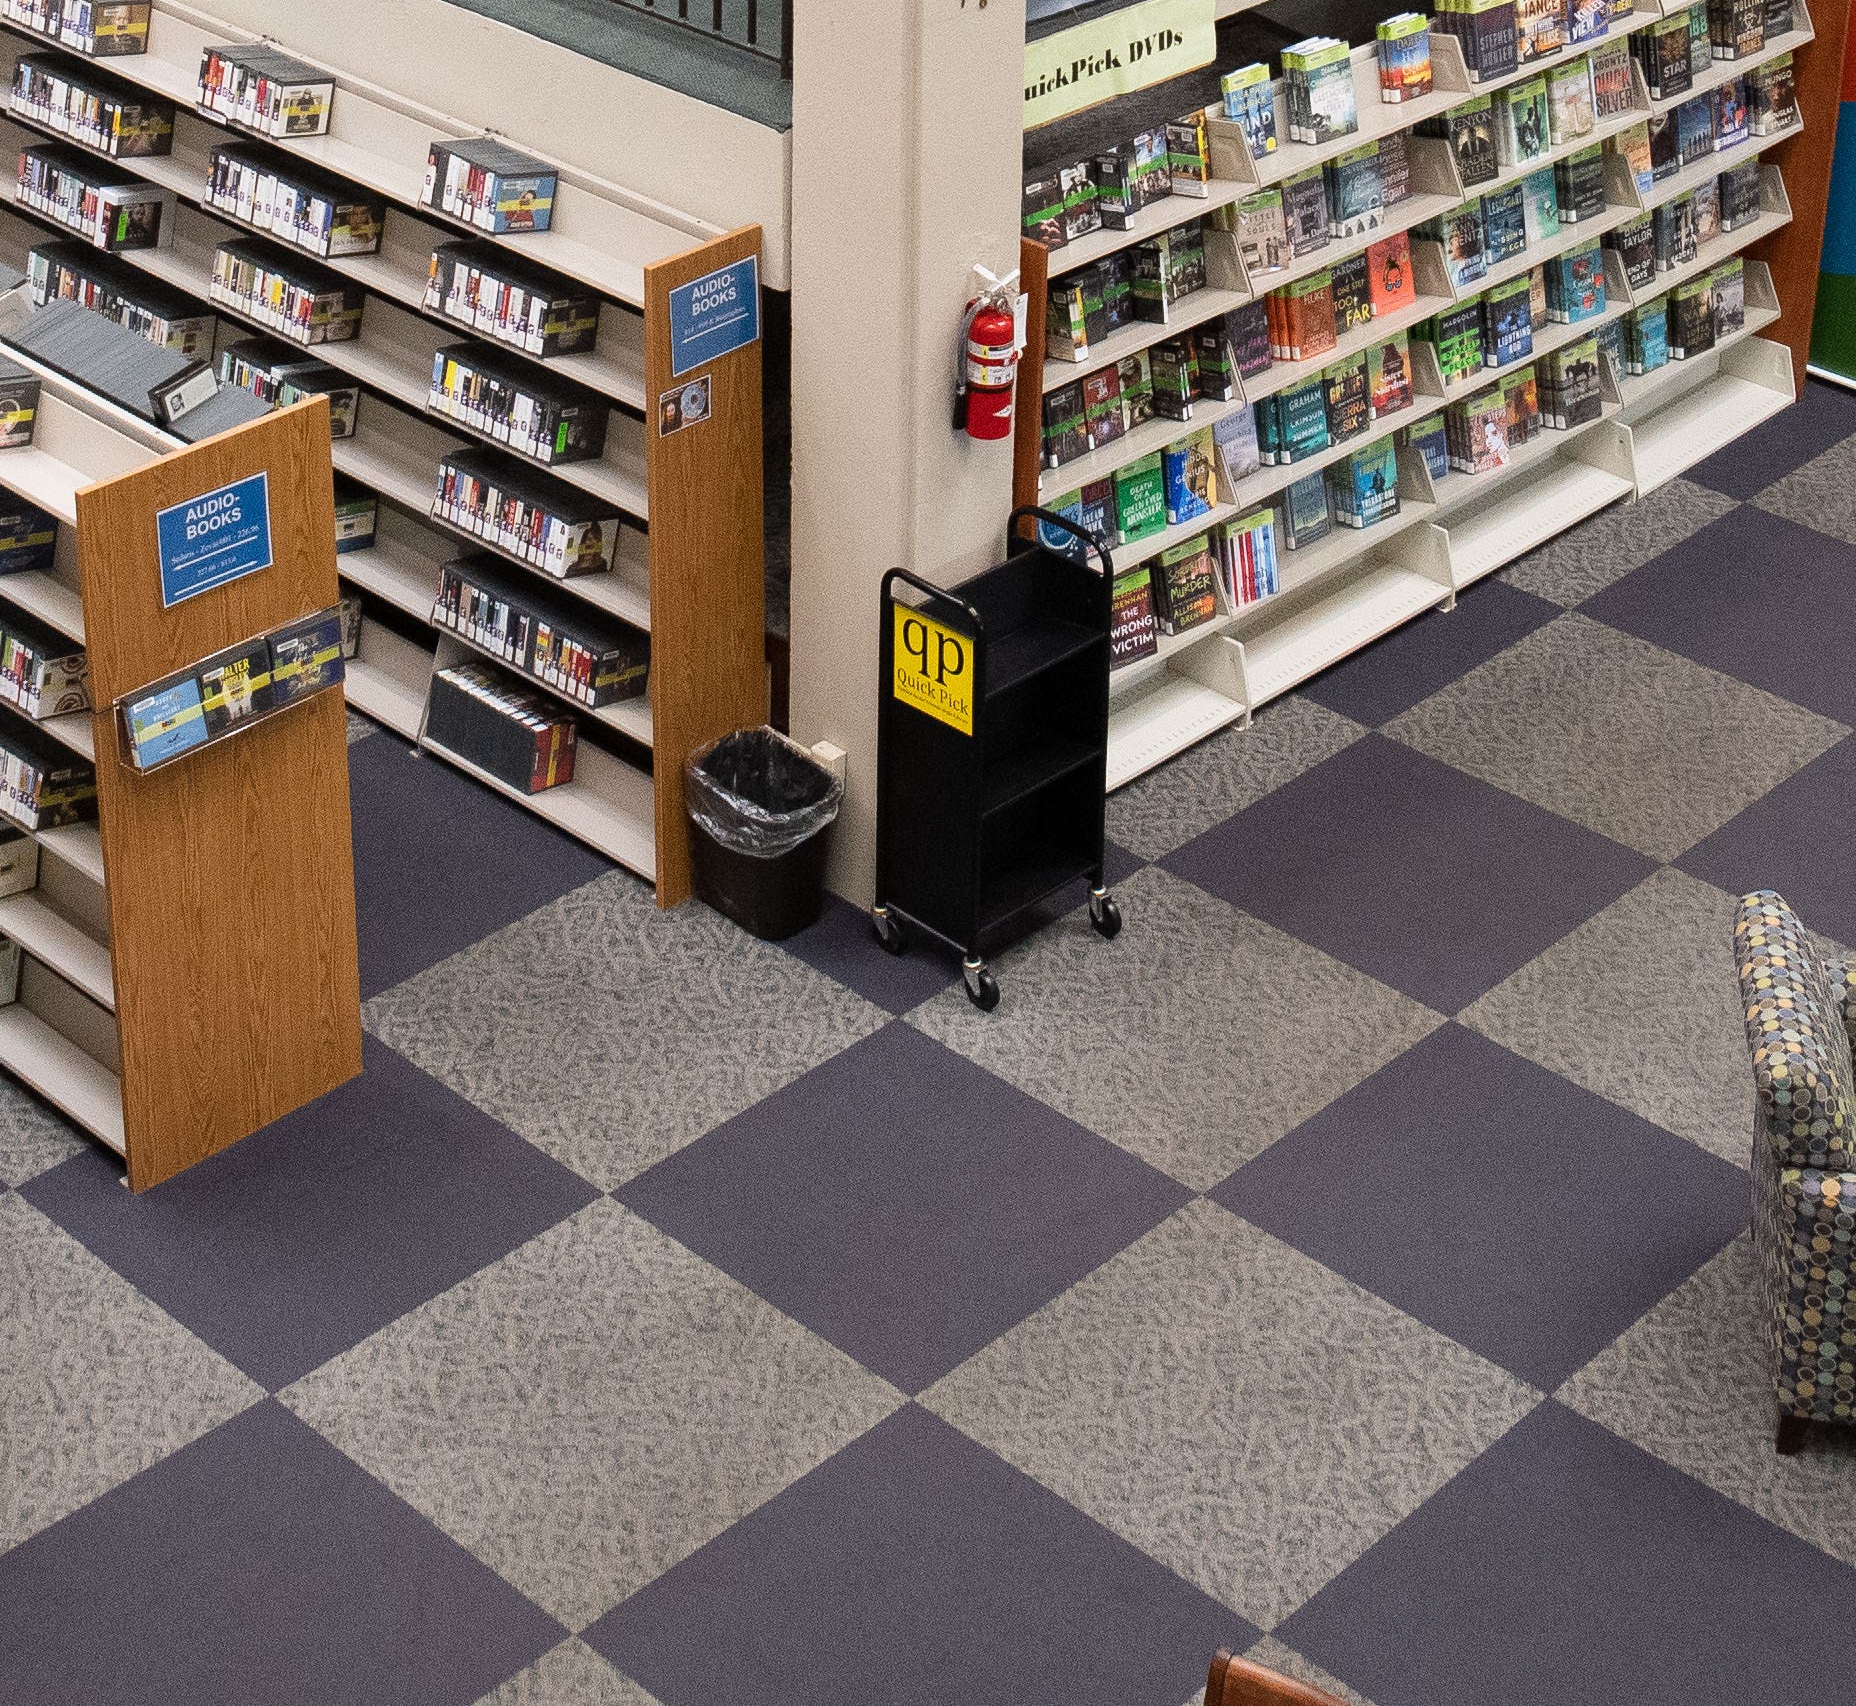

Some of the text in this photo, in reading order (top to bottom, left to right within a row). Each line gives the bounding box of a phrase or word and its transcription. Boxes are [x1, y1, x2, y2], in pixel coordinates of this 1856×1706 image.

[1479, 27, 1514, 51] STEPHEN
[1024, 27, 1183, 102] uickPick DVDs
[1481, 44, 1514, 67] HUNTER
[1594, 54, 1629, 72] KOONTZ
[1663, 59, 1687, 78] STAR
[1595, 87, 1633, 118] SILVER
[1450, 108, 1494, 132] KENYON
[1622, 227, 1653, 250] TAYLOR
[1330, 256, 1367, 280] GARDNER
[1630, 270, 1648, 284] DAYS
[692, 273, 736, 302] AUDIO-
[692, 286, 737, 316] BOOKS
[1345, 302, 1371, 326] FAR
[1442, 308, 1478, 329] MARGOLIN
[1497, 326, 1532, 348] LIGHTNING
[1288, 389, 1322, 411] GRAHAM
[1334, 399, 1367, 421] SIERRA
[1289, 408, 1324, 428] CRIMSON
[1341, 415, 1361, 434] SIX
[1292, 424, 1323, 442] SUMMER
[1129, 481, 1154, 499] DEATH
[185, 492, 241, 524] AUDIO-
[1126, 502, 1164, 525] MONSTER
[186, 507, 242, 540] BOOKS
[1170, 575, 1211, 602] MURDER
[1121, 607, 1139, 621] THE
[1110, 613, 1153, 640] WRONG
[903, 618, 964, 687] qp
[1112, 632, 1154, 655] VICTIM
[897, 667, 936, 699] Quick
[939, 688, 970, 716] Pick
